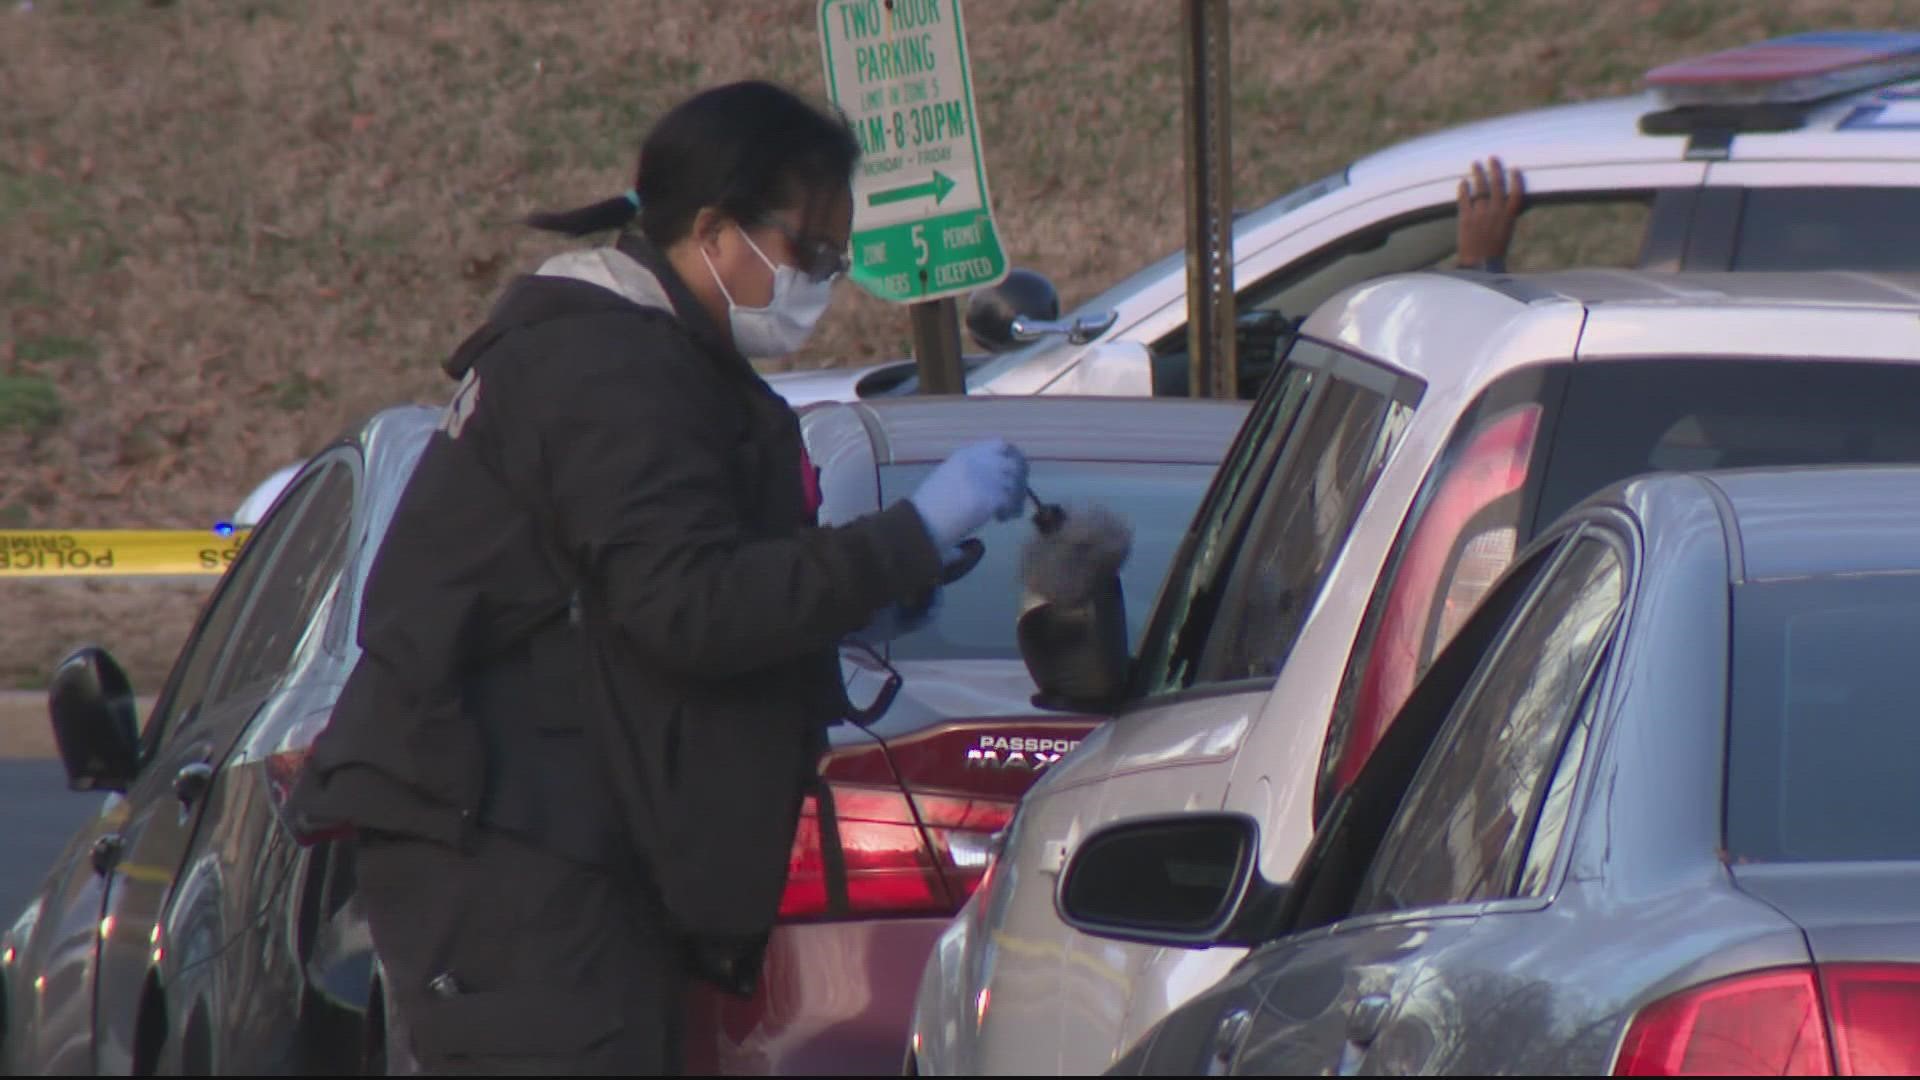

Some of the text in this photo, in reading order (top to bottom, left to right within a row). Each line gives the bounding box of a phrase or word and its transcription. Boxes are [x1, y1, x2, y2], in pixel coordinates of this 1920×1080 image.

[840, 0, 940, 40] TWO HOUR
[856, 33, 935, 84] PARKING
[911, 224, 928, 265] 5
